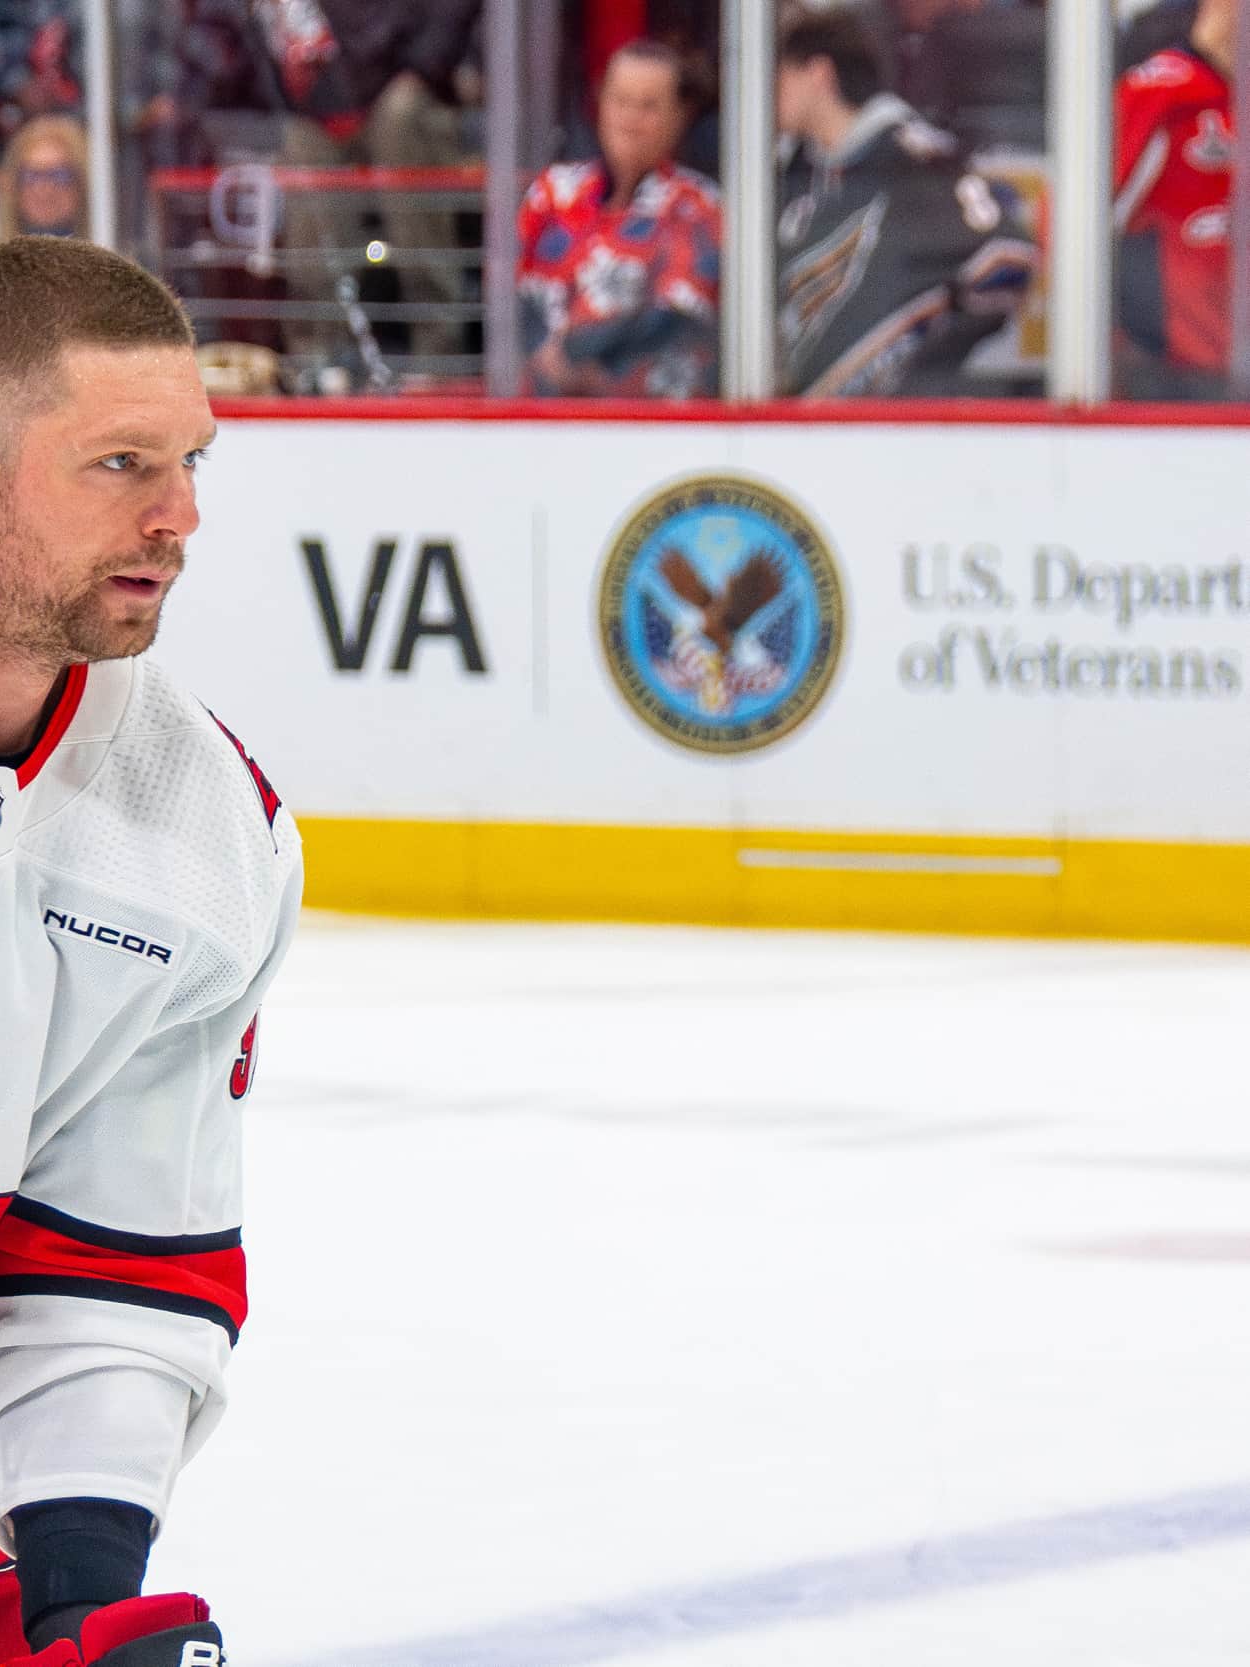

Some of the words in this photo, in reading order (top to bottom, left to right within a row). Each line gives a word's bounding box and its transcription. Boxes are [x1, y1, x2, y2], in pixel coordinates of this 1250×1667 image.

[299, 538, 488, 674] VA
[900, 544, 1016, 609] U.S.
[1033, 544, 1250, 627] Depart
[899, 622, 970, 692] of
[973, 625, 1242, 696] Veterans
[44, 908, 172, 964] NUCOR
